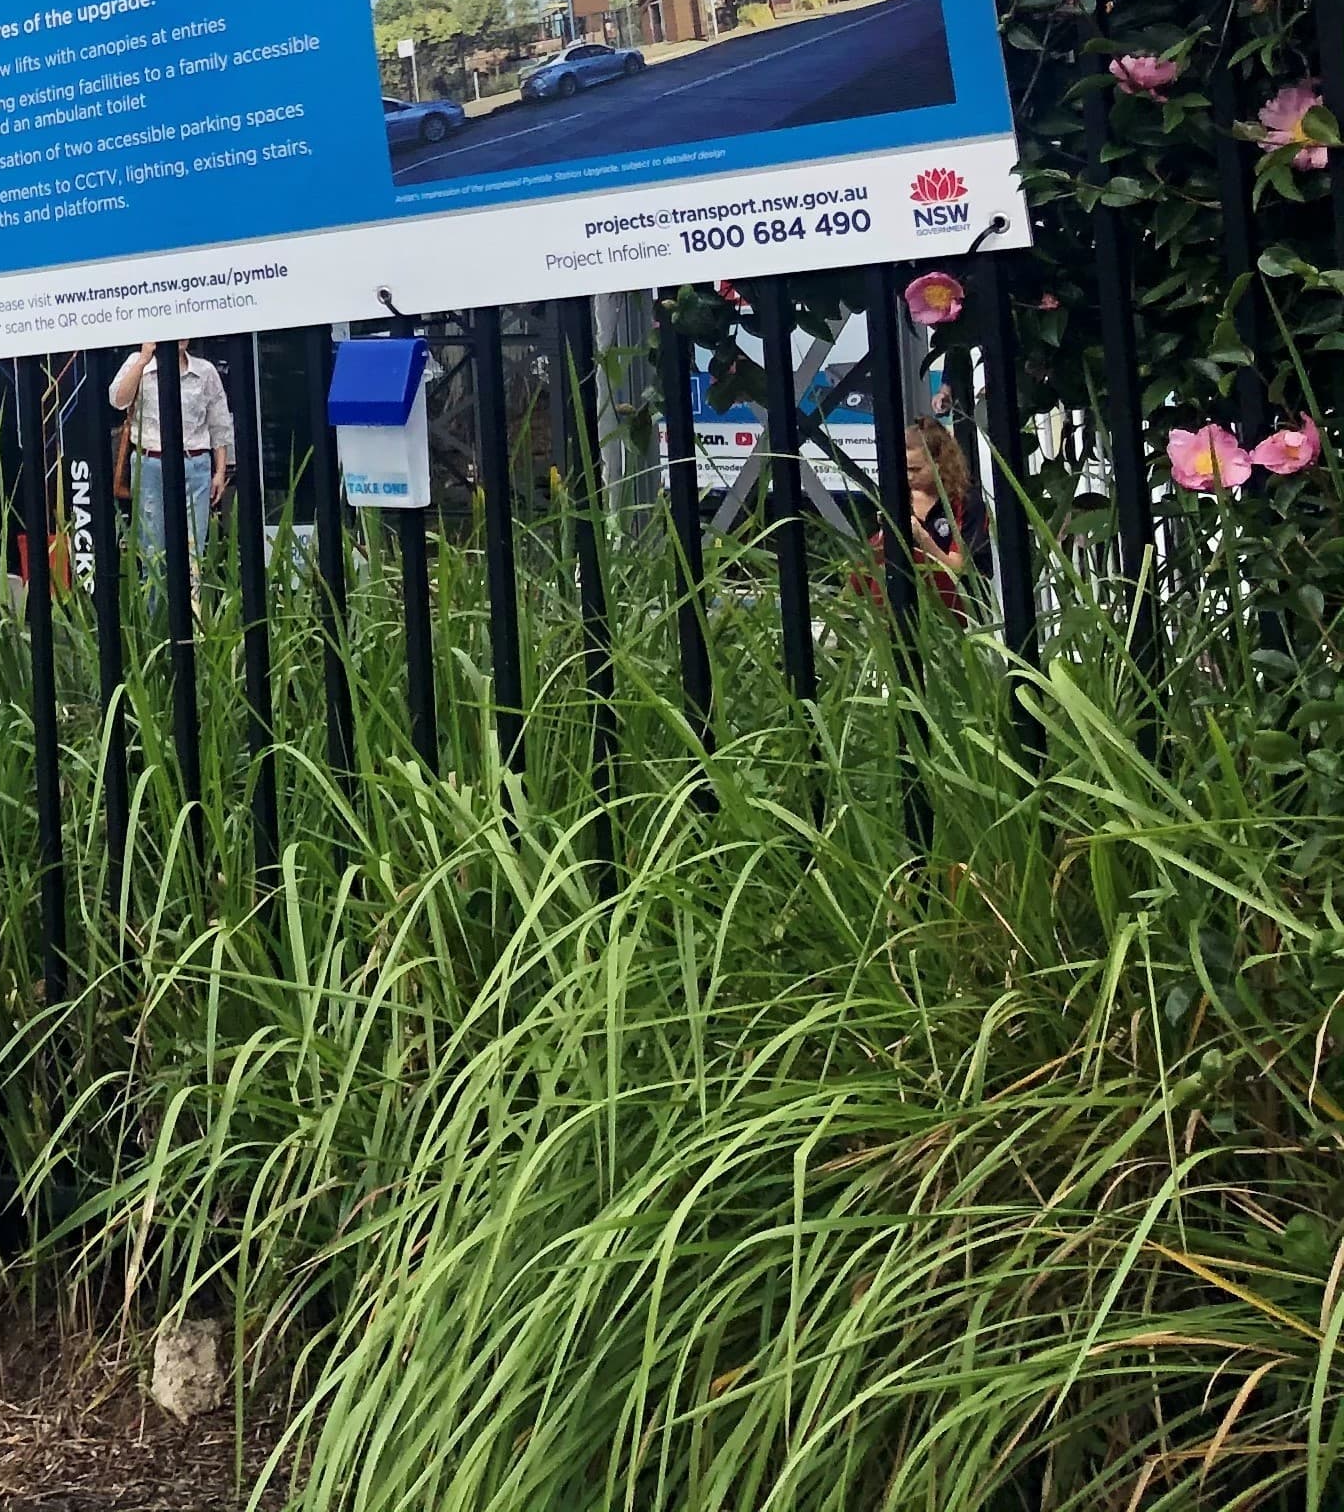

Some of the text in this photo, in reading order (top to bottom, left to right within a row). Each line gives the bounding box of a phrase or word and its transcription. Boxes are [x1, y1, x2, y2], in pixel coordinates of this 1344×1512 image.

[23, 12, 41, 33] of
[45, 9, 73, 29] the
[14, 55, 41, 74] lifts
[44, 47, 76, 68] with
[80, 34, 147, 61] canopies
[151, 28, 167, 46] at
[171, 17, 226, 41] entries
[19, 82, 75, 107] existing
[78, 70, 140, 96] facilities
[144, 67, 161, 83] to
[165, 65, 175, 79] a
[179, 52, 228, 76] family
[233, 33, 320, 65] accessible
[13, 118, 31, 133] an
[34, 103, 103, 129] ambulant
[106, 93, 147, 116] toilet
[45, 142, 62, 161] of
[64, 141, 93, 158] two
[97, 123, 176, 152] accessible
[180, 114, 241, 141] parking
[246, 102, 305, 127] spaces
[55, 179, 71, 194] to
[74, 168, 123, 192] CCTV,
[125, 160, 190, 185] lighting,
[193, 148, 258, 172] existing
[262, 138, 313, 161] stairs,
[23, 203, 51, 223] and
[54, 194, 130, 221] platforms.
[585, 185, 868, 238] projects@transport.nsw.gov.au
[913, 202, 968, 228] NSW
[545, 208, 872, 271] Project Infoline: 1800 684 490
[27, 293, 53, 309] visit
[54, 262, 288, 305] www.transport.nsw.gov.au/pymble
[4, 319, 32, 335] scan
[34, 315, 55, 332] the
[57, 311, 79, 331] QR
[81, 309, 113, 326] code
[115, 304, 134, 322] for
[137, 301, 172, 319] more
[174, 292, 258, 316] information.
[348, 482, 380, 495] TAKE
